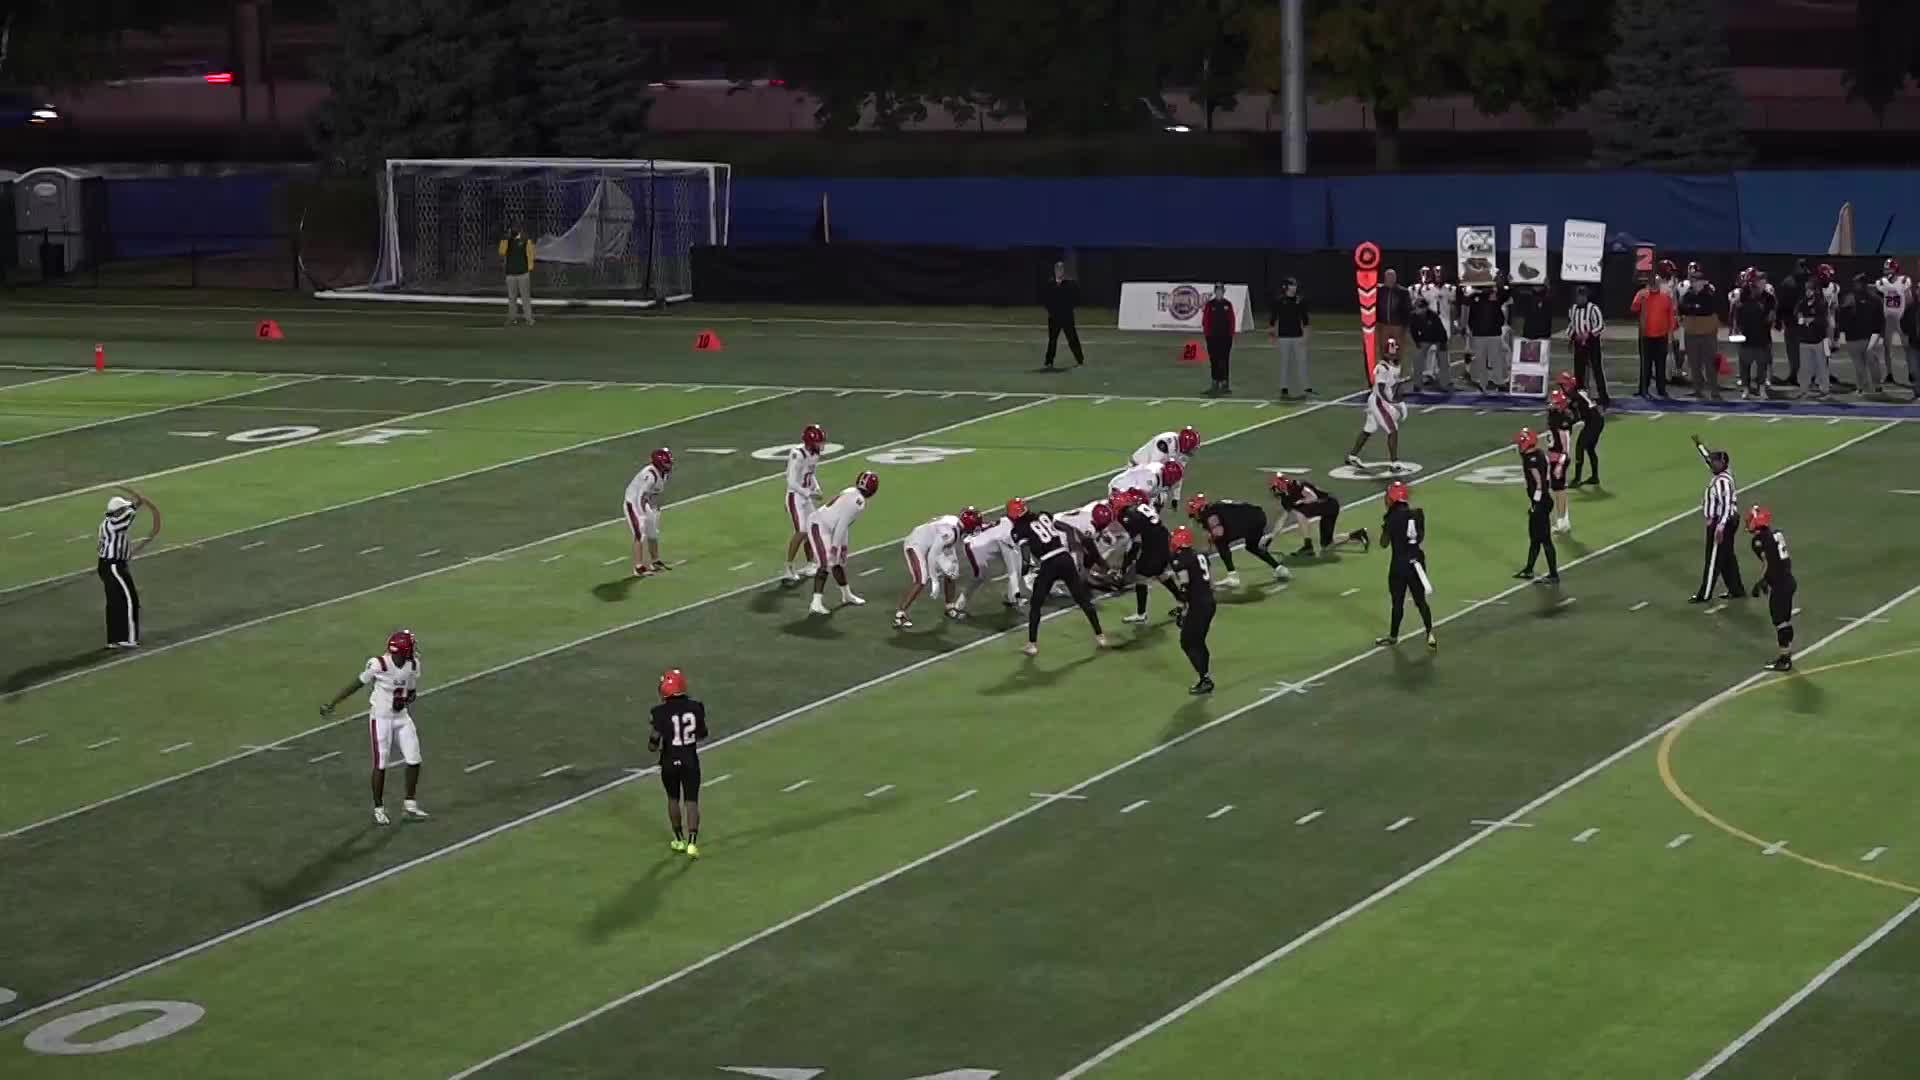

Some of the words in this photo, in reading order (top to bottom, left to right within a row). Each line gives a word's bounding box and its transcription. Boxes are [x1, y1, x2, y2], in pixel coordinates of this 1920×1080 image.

[1636, 247, 1653, 270] 2
[259, 323, 271, 337] G
[696, 334, 711, 349] 10
[1406, 519, 1418, 544] 4
[671, 712, 696, 746] 12
[0, 986, 206, 1056] 0
